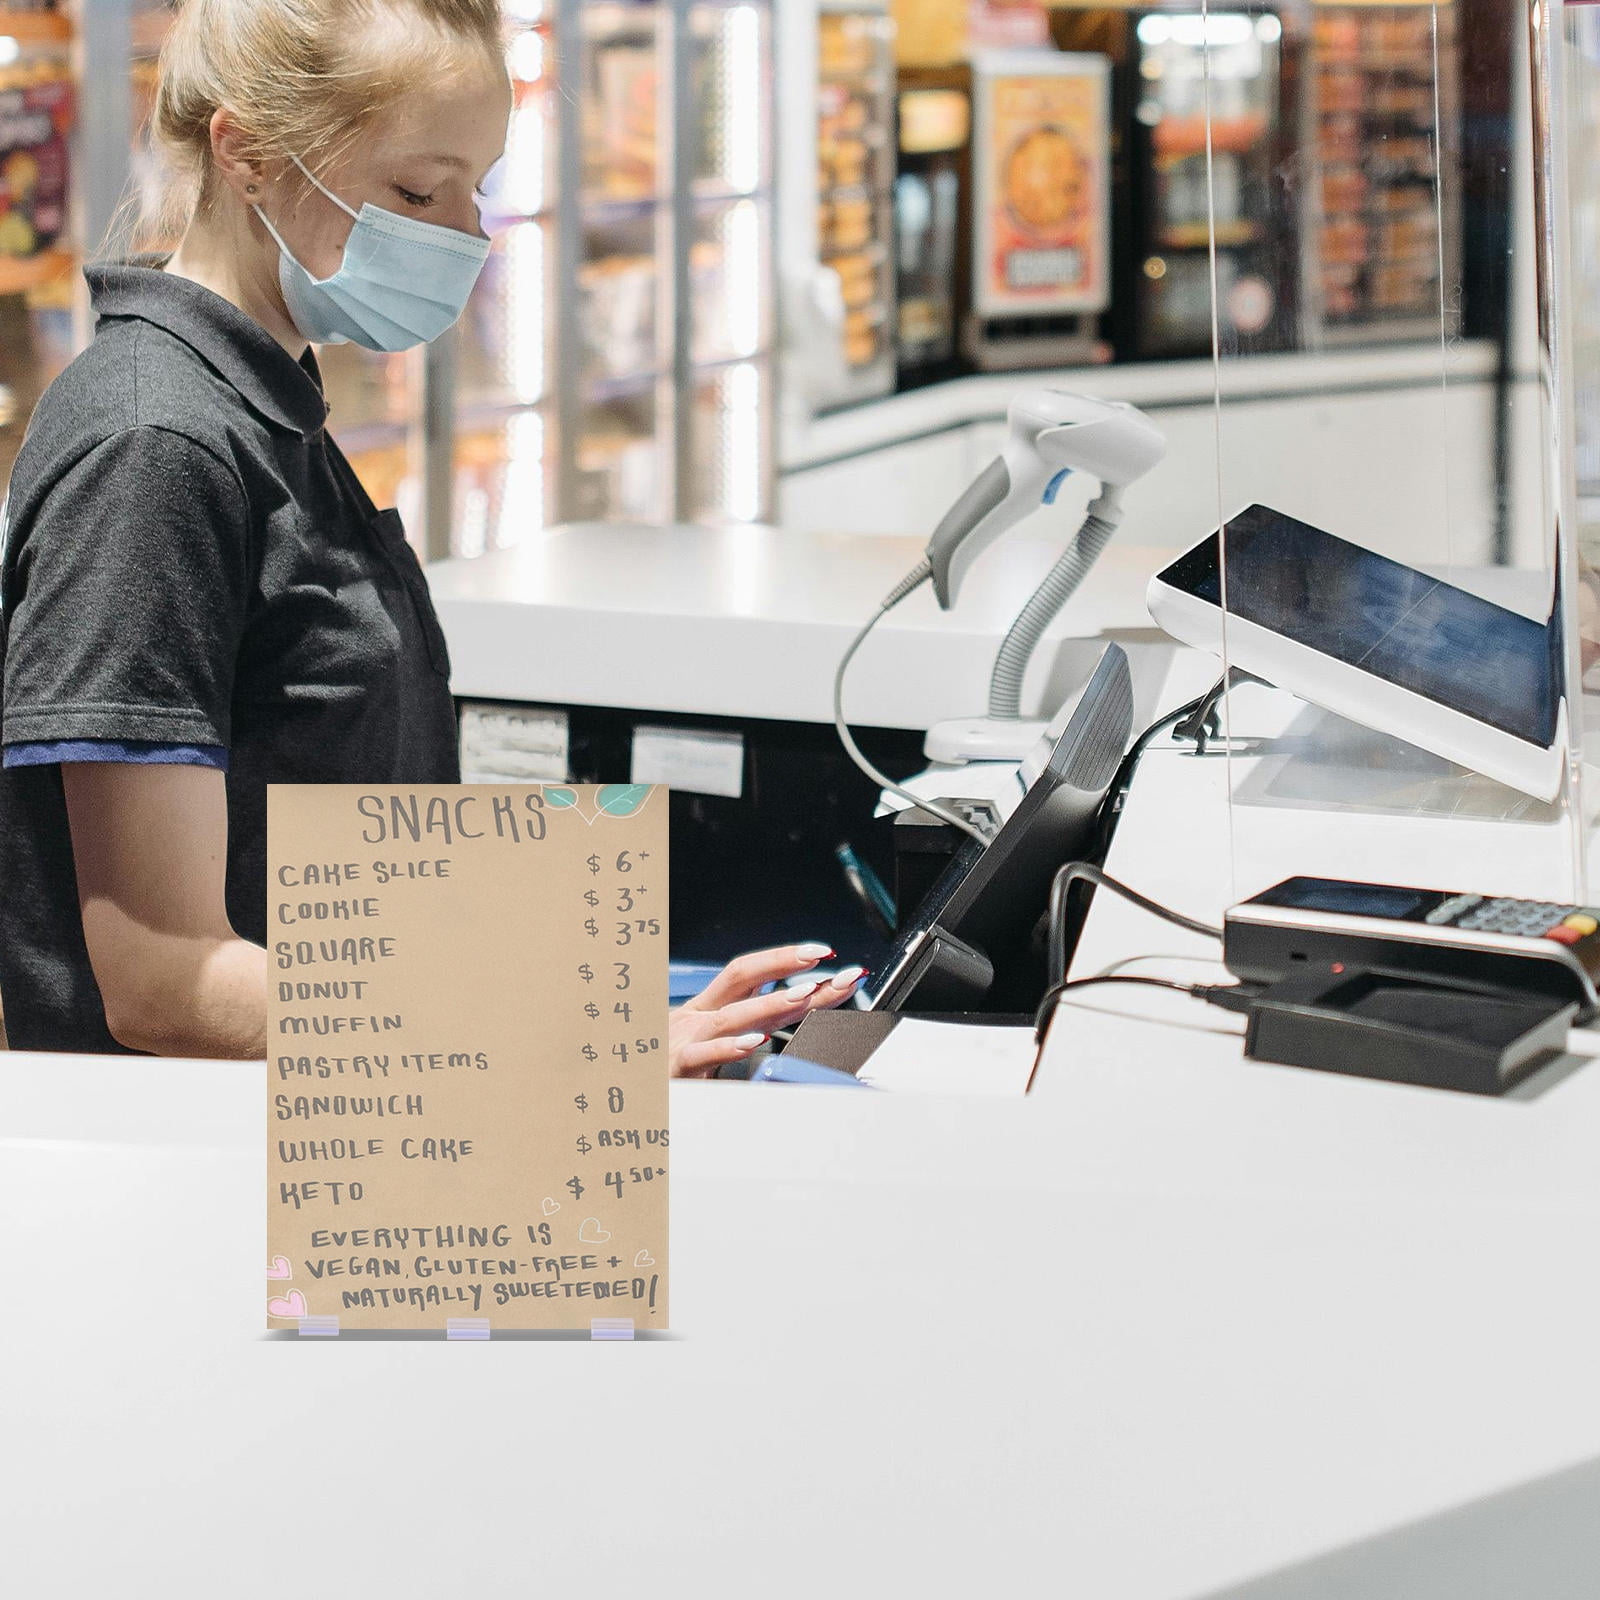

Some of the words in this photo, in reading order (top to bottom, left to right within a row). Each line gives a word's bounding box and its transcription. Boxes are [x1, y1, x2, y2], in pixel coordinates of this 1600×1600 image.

[357, 793, 547, 845] SNACKS
[277, 863, 361, 888] CAKE
[372, 858, 452, 884] SLICE
[277, 897, 380, 925] COOKIE
[275, 936, 397, 970] SQUARE
[278, 980, 369, 1003] DONUT
[613, 962, 631, 991] 3
[279, 1014, 403, 1036] MUFFIN
[613, 1001, 633, 1023] 4
[277, 1054, 390, 1081] PASTRY
[401, 1051, 489, 1073] ITEMS
[274, 1094, 424, 1121] SANDWICH
[607, 1086, 625, 1114] 8
[278, 1138, 384, 1164] WHOLE
[400, 1137, 473, 1163] CAKE
[597, 1128, 641, 1151] ASK
[645, 1128, 669, 1148] US
[279, 1181, 364, 1210] KETO
[311, 1224, 513, 1250] EVERYTHING
[526, 1222, 552, 1246] IS
[413, 1254, 599, 1281] GLUTEN-FREE
[606, 1255, 623, 1269] +
[341, 1283, 483, 1312] NATURALLY
